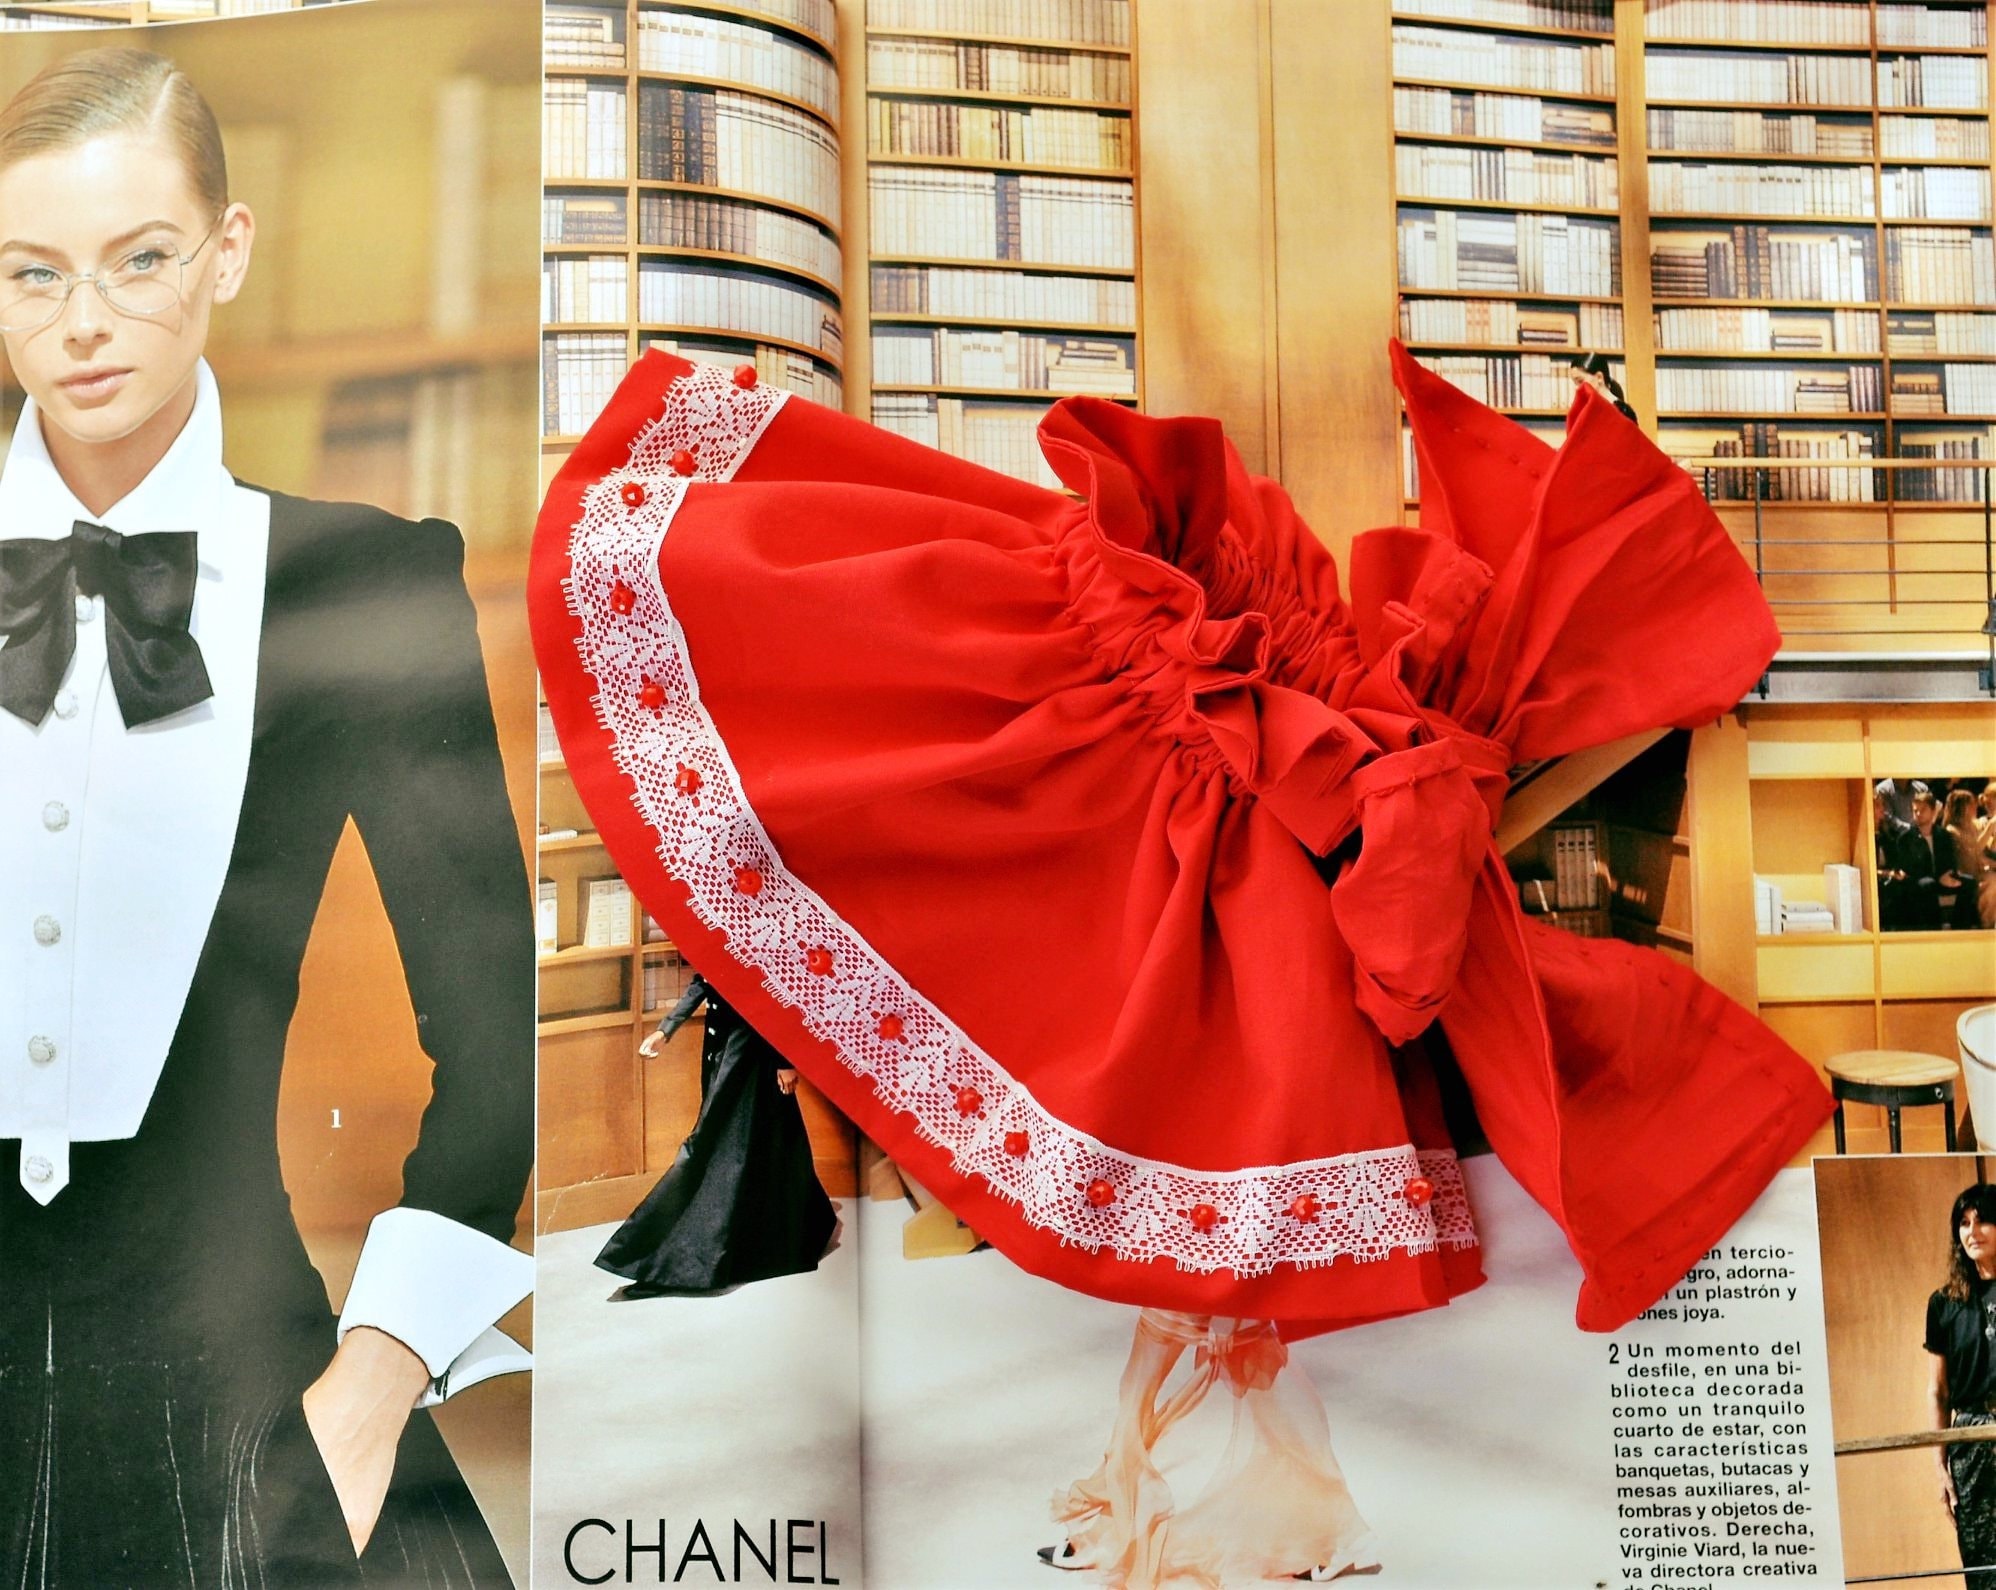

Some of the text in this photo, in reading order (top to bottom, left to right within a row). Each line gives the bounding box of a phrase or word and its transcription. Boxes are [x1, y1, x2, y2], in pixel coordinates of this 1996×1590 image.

[331, 1108, 342, 1129] 1
[1730, 1246, 1793, 1260] tercio-
[1681, 1265, 1795, 1284] gro, adorna-
[1675, 1288, 1698, 1300] un
[1705, 1284, 1780, 1303] plastrón
[1787, 1287, 1797, 1301] y
[1683, 1304, 1725, 1323] joya.
[1608, 1341, 1801, 1365] 2 Un momento del
[1627, 1361, 1803, 1379] desfile, en una bi-
[1611, 1380, 1804, 1398] blioteca decorada
[1612, 1400, 1805, 1419] como un tranquilo
[1613, 1422, 1807, 1438] cuarto de estar, con
[1614, 1440, 1808, 1458] las características
[1615, 1461, 1809, 1481] banquetas, butacas y
[1617, 1480, 1810, 1498] mesas auxiliares, al-
[1617, 1500, 1812, 1521] fombras y objetos de-
[1619, 1520, 1814, 1539] corativos. Derecha,
[564, 1518, 840, 1585] CHANEL
[1620, 1541, 1816, 1562] Virginie Viard, la nue-
[1621, 1560, 1817, 1579] va directora creativa
